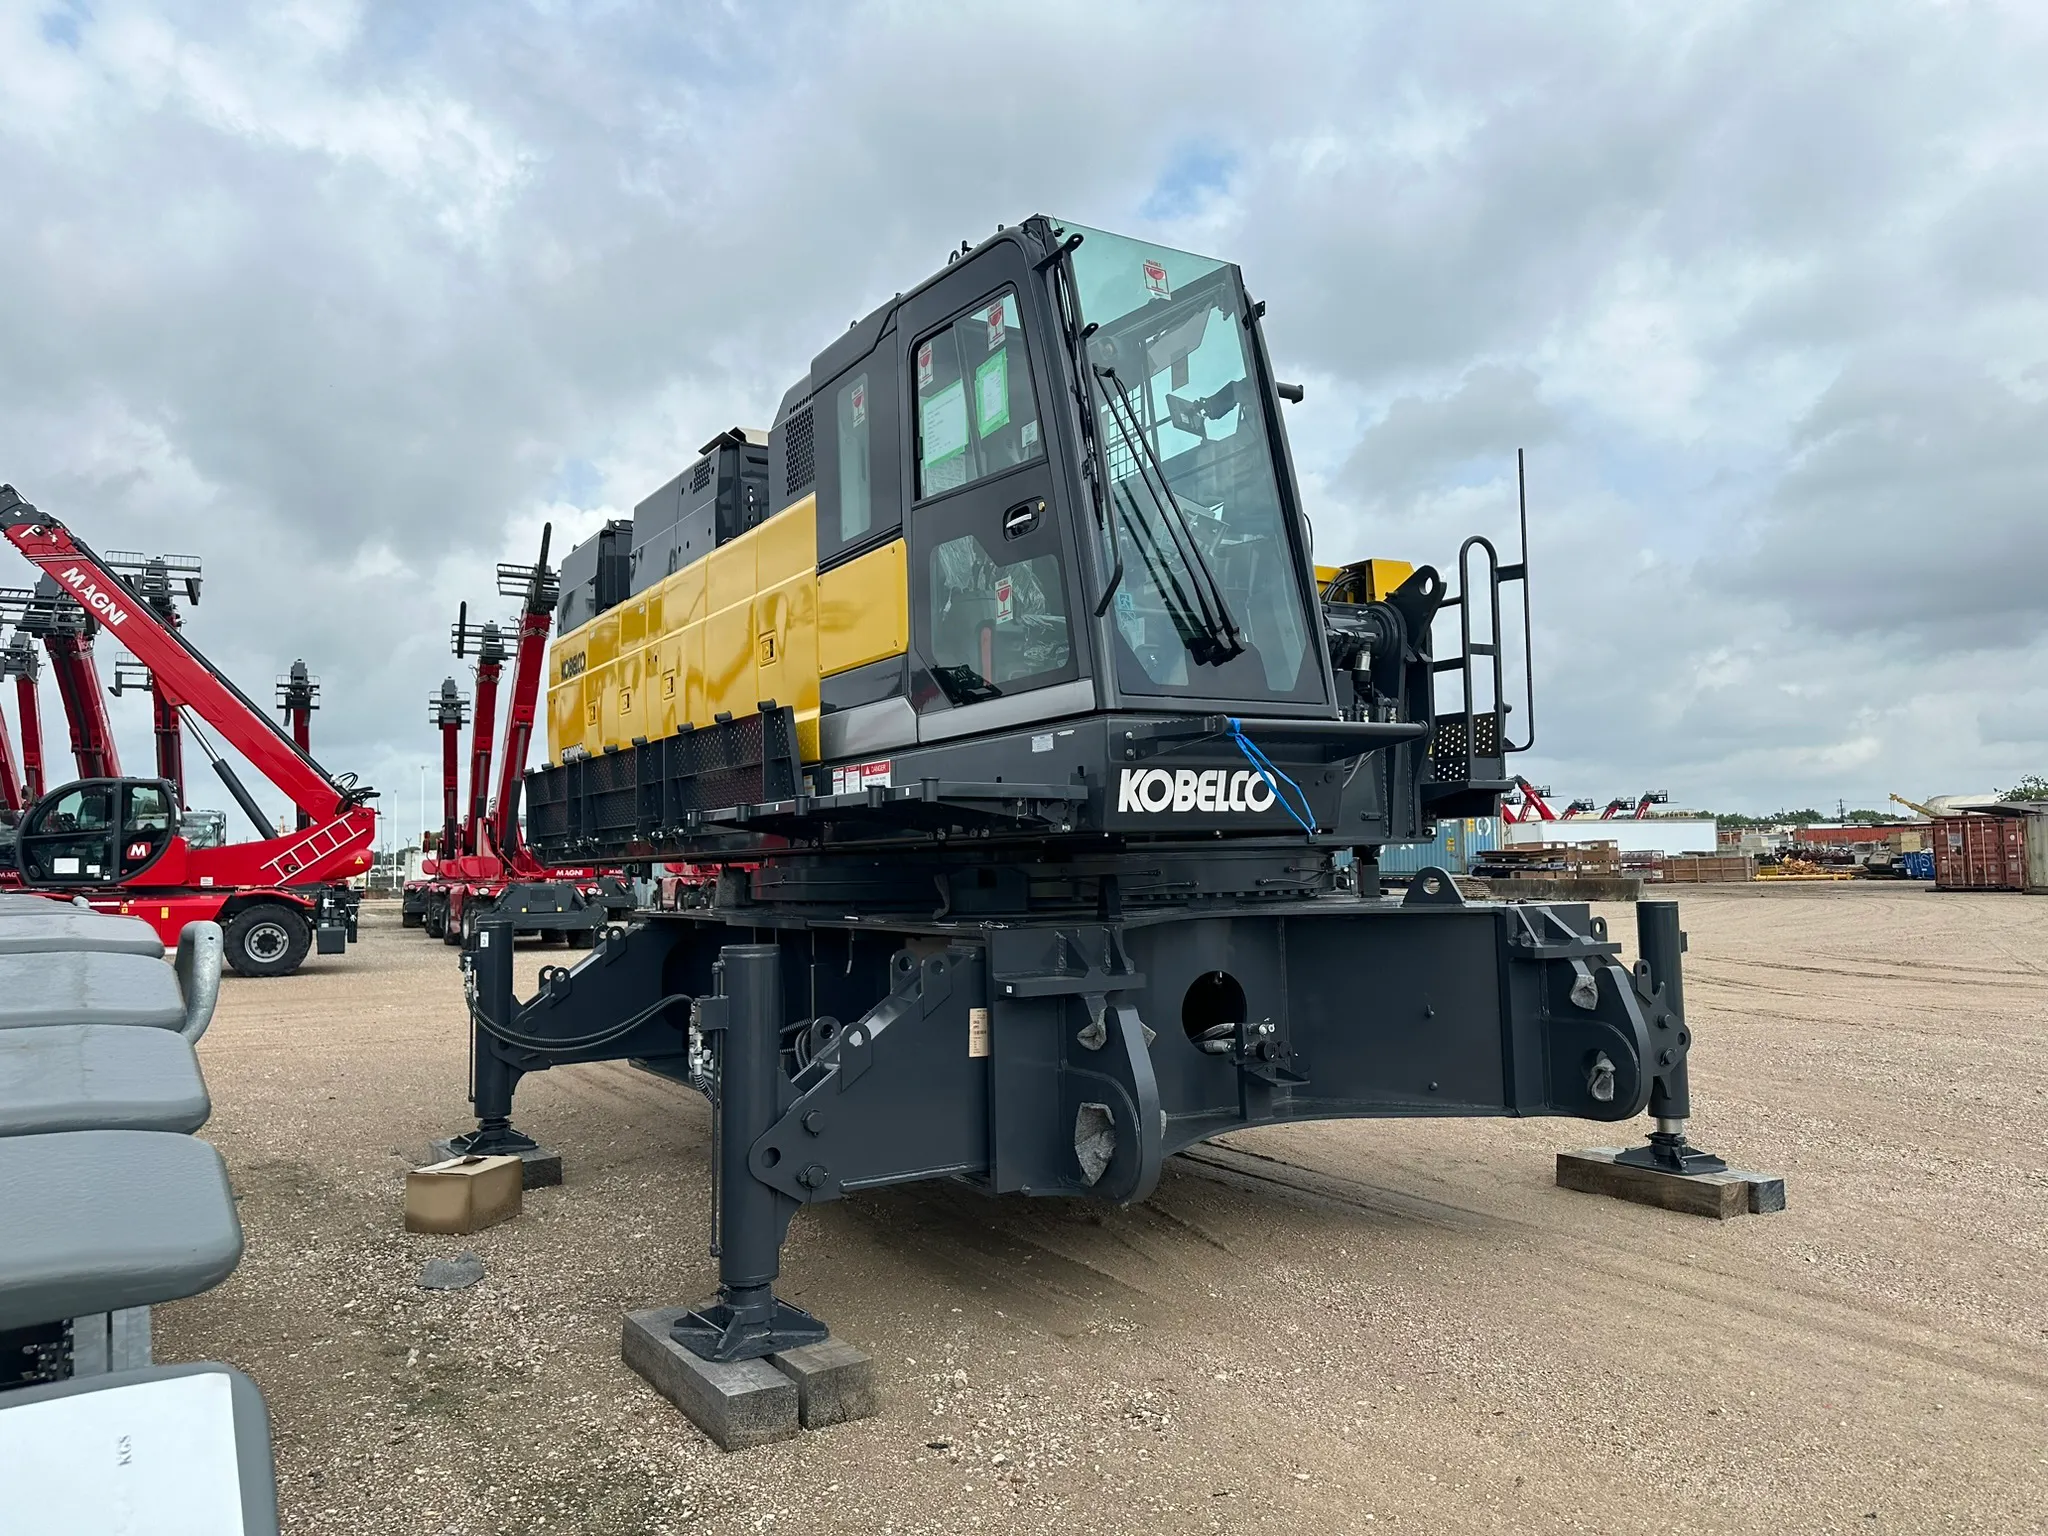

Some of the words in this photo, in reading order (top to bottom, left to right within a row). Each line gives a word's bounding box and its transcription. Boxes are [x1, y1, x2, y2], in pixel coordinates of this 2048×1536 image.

[61, 567, 128, 626] MAGNI
[561, 651, 586, 681] KOBELCO
[1117, 768, 1278, 813] KOBELCO
[130, 844, 146, 857] M
